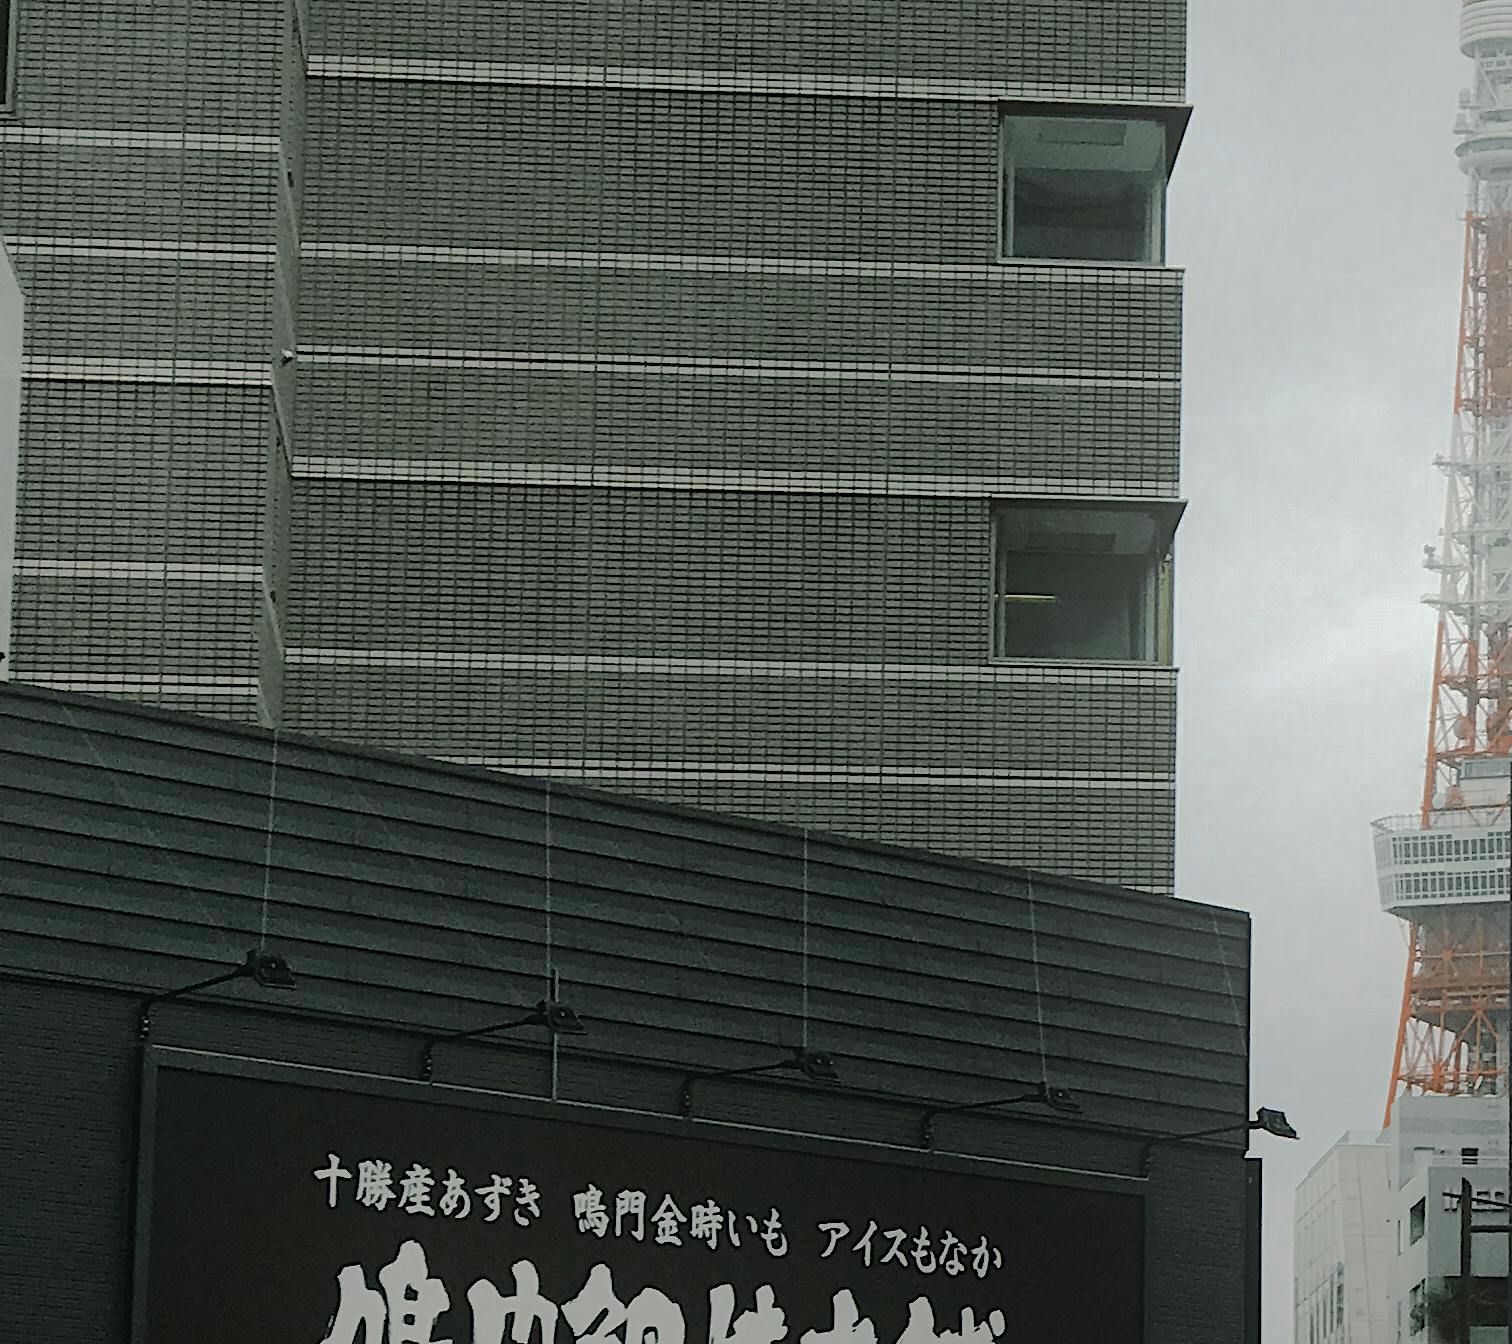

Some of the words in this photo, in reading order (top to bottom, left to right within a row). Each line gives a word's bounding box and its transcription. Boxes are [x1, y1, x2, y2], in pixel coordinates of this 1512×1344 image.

[313, 1153, 542, 1227] 十勝産あずき
[573, 1184, 790, 1257] 鳴門金時いも
[818, 1220, 1003, 1279] アイスもなか
